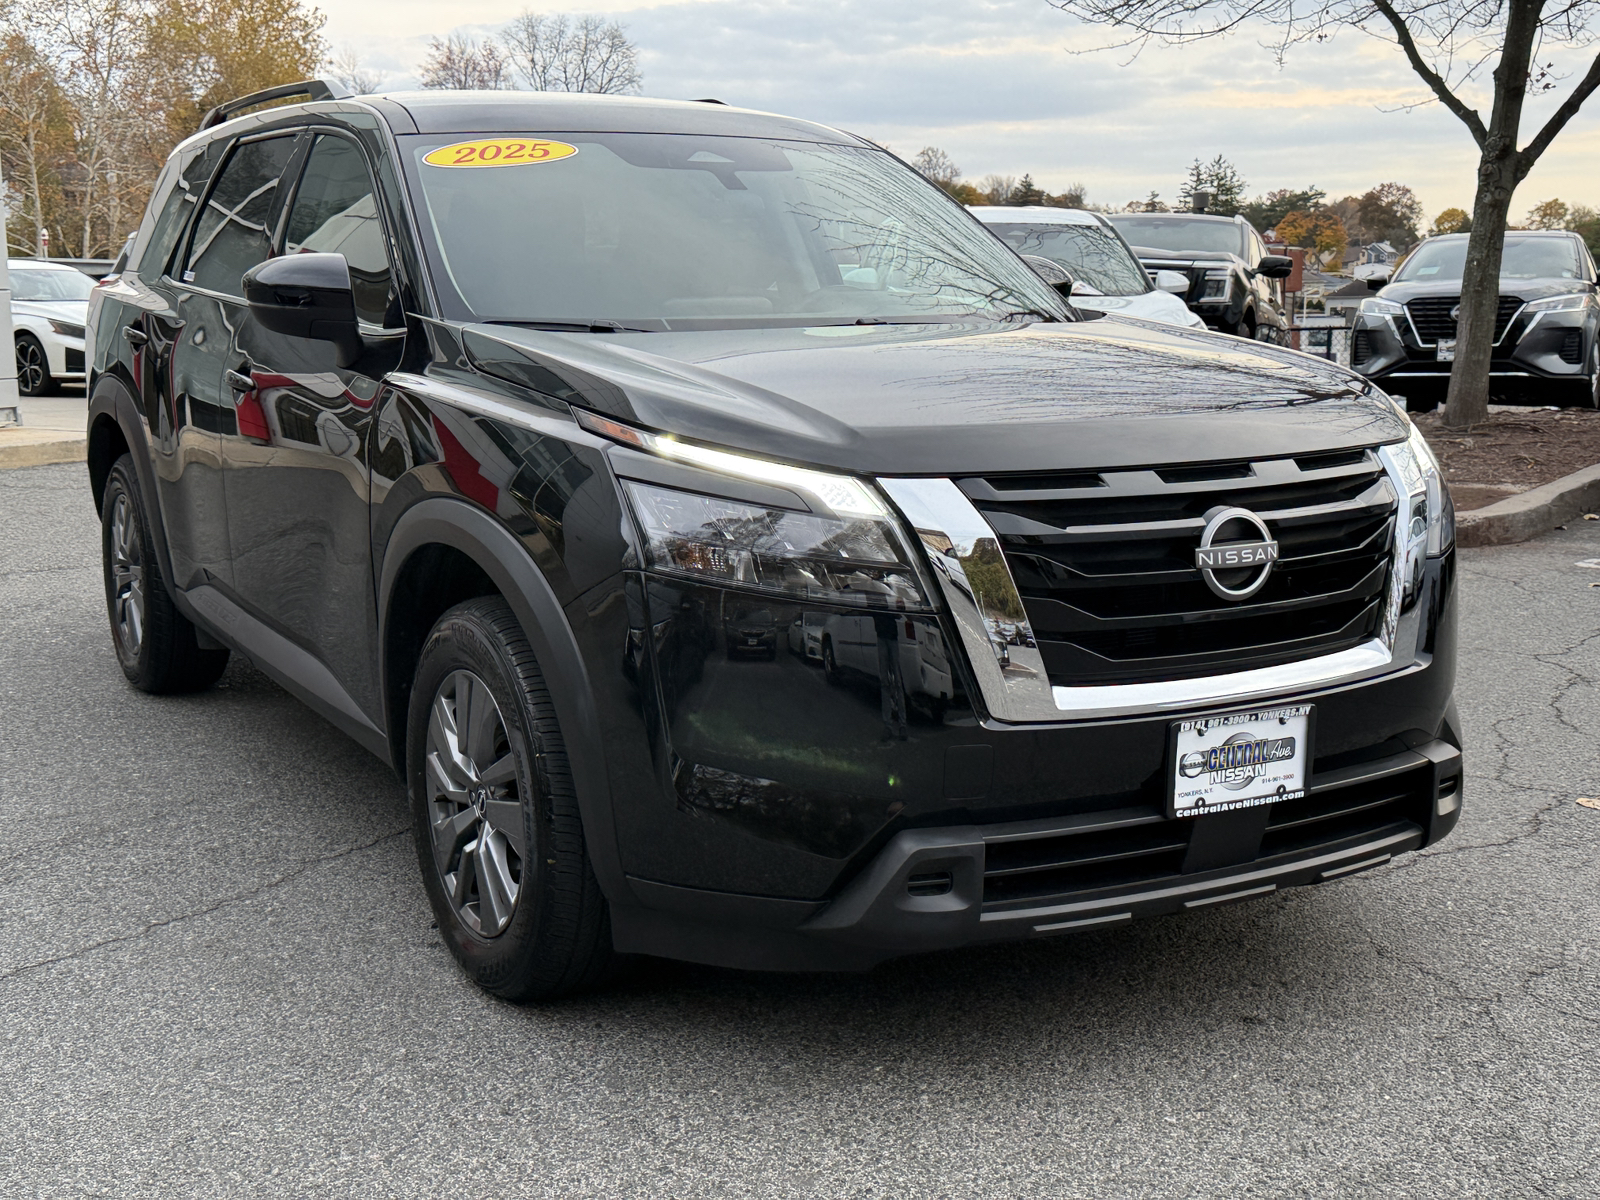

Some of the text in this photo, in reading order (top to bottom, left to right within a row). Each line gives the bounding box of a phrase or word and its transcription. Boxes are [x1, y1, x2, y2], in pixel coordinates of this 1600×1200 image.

[453, 143, 550, 164] 2025
[1199, 545, 1277, 566] NISSAN
[1208, 739, 1268, 771] CENTRAL
[1210, 763, 1266, 785] NISSAN
